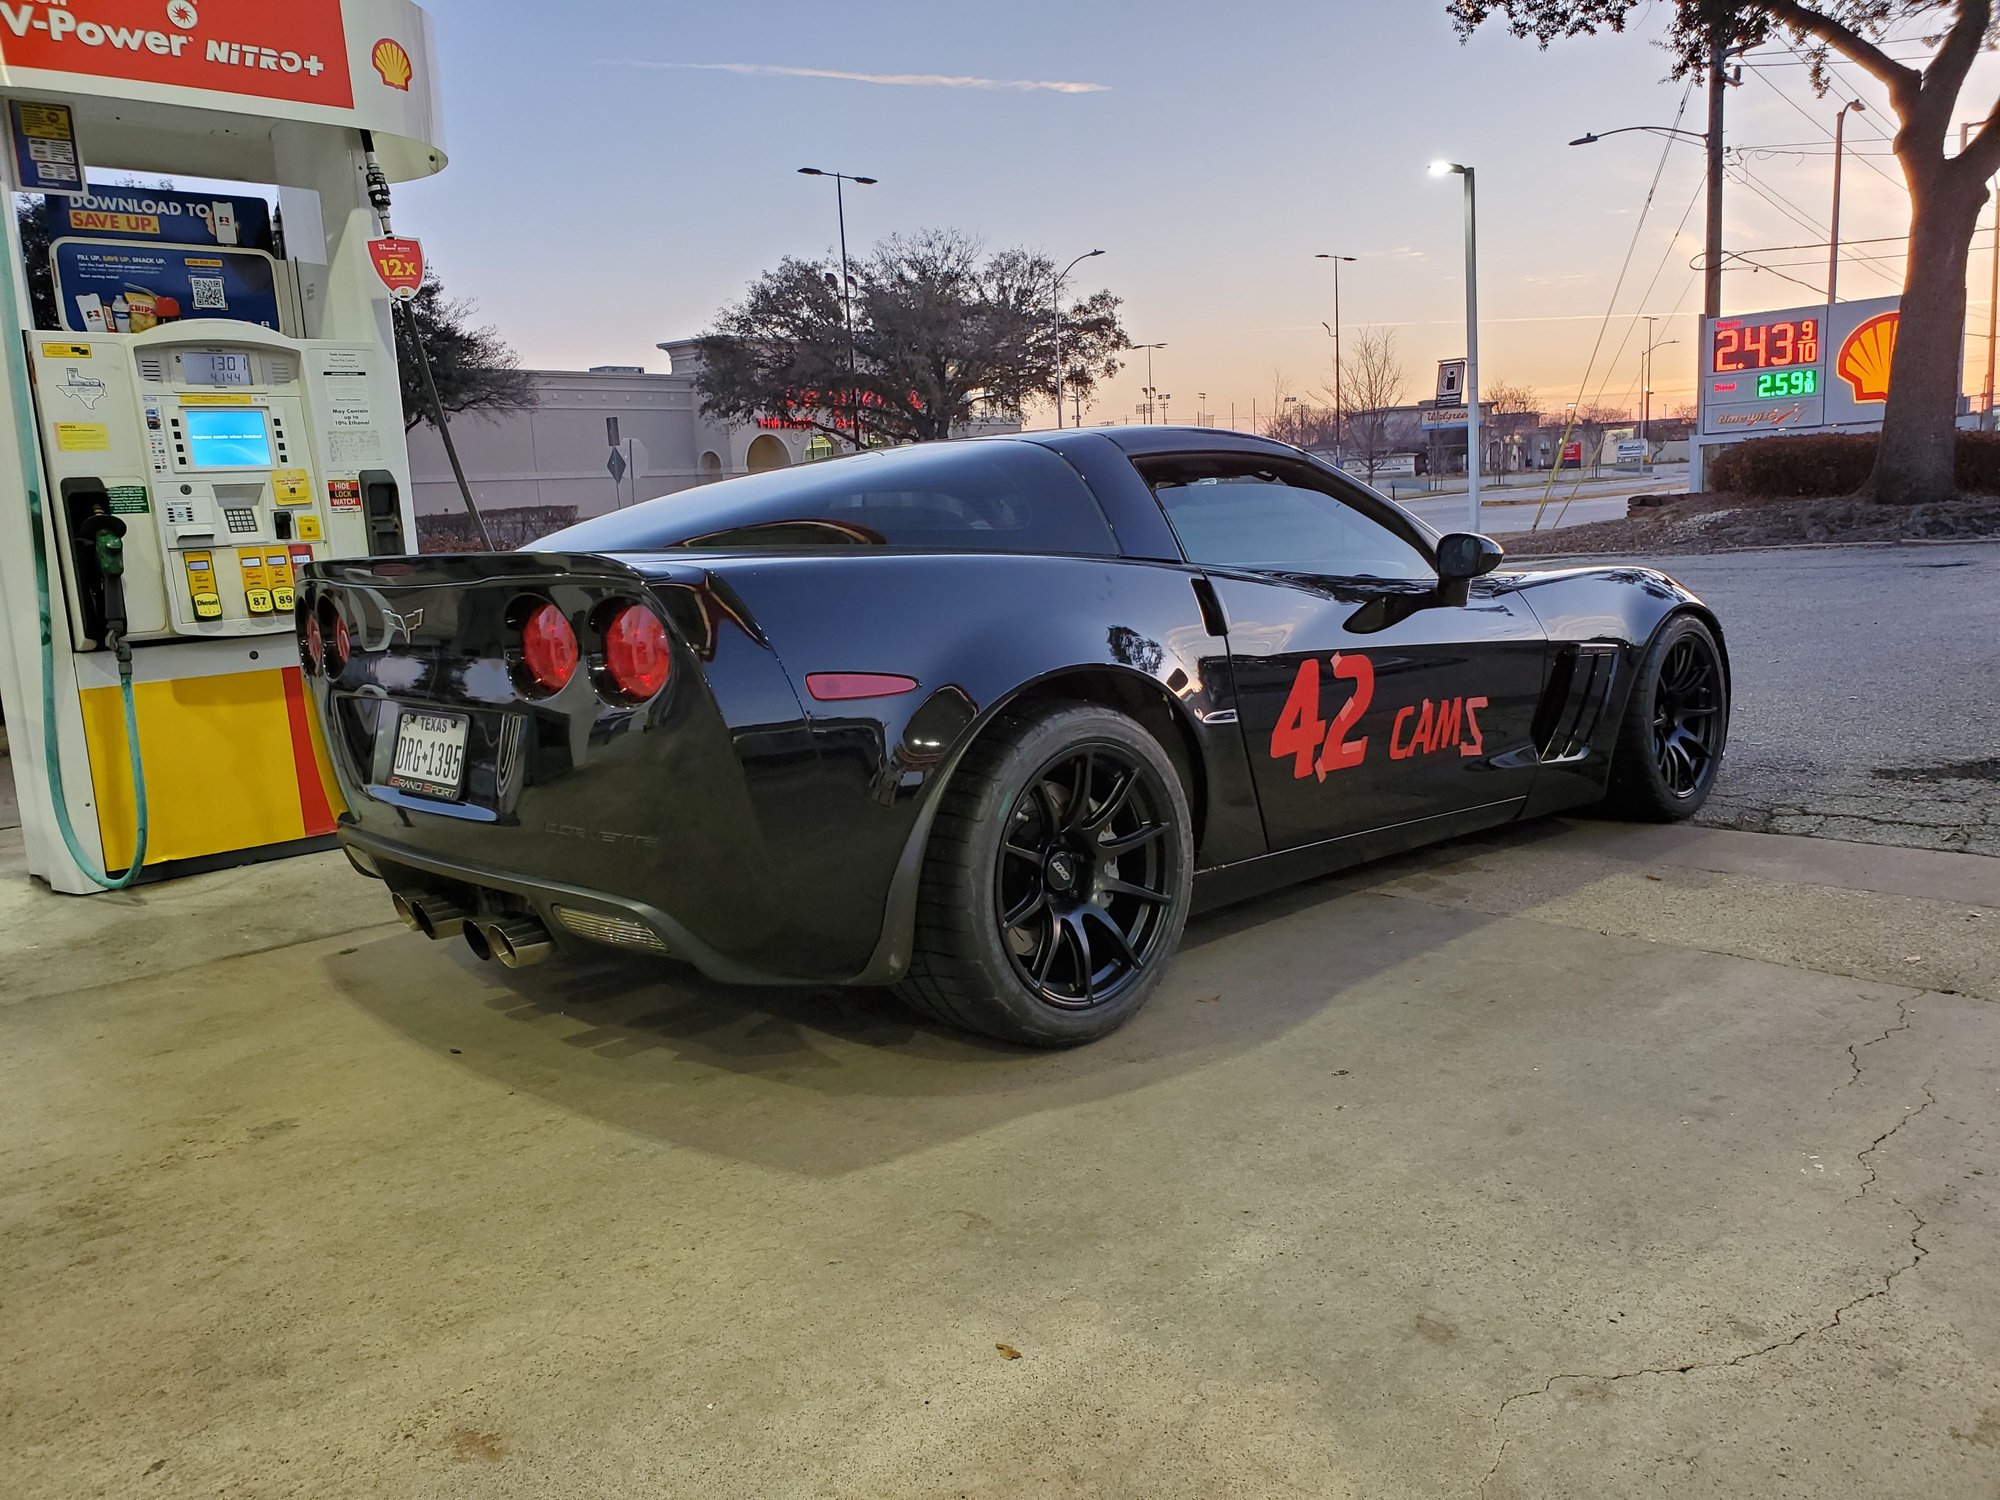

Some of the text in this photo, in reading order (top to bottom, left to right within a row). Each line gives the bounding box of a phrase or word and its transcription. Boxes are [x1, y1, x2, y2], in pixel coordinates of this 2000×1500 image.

[0, 2, 187, 56] V-Power
[69, 194, 210, 218] DOWNLOAD TO
[72, 211, 158, 232] SAVE UP.
[128, 304, 155, 314] CHIPS
[1716, 323, 1794, 371] 2.43
[1758, 371, 1804, 397] 2.59
[1426, 410, 1469, 423] Walgree
[334, 482, 351, 490] HIDE
[334, 490, 353, 498] LOCK
[332, 498, 356, 506] WATCH
[196, 599, 218, 607] Diesel
[253, 596, 267, 606] 87
[278, 594, 293, 605] 89
[1270, 651, 1489, 783] 42 CAMS
[420, 716, 448, 734] TEXAS
[389, 775, 457, 798] GRAND SPORT
